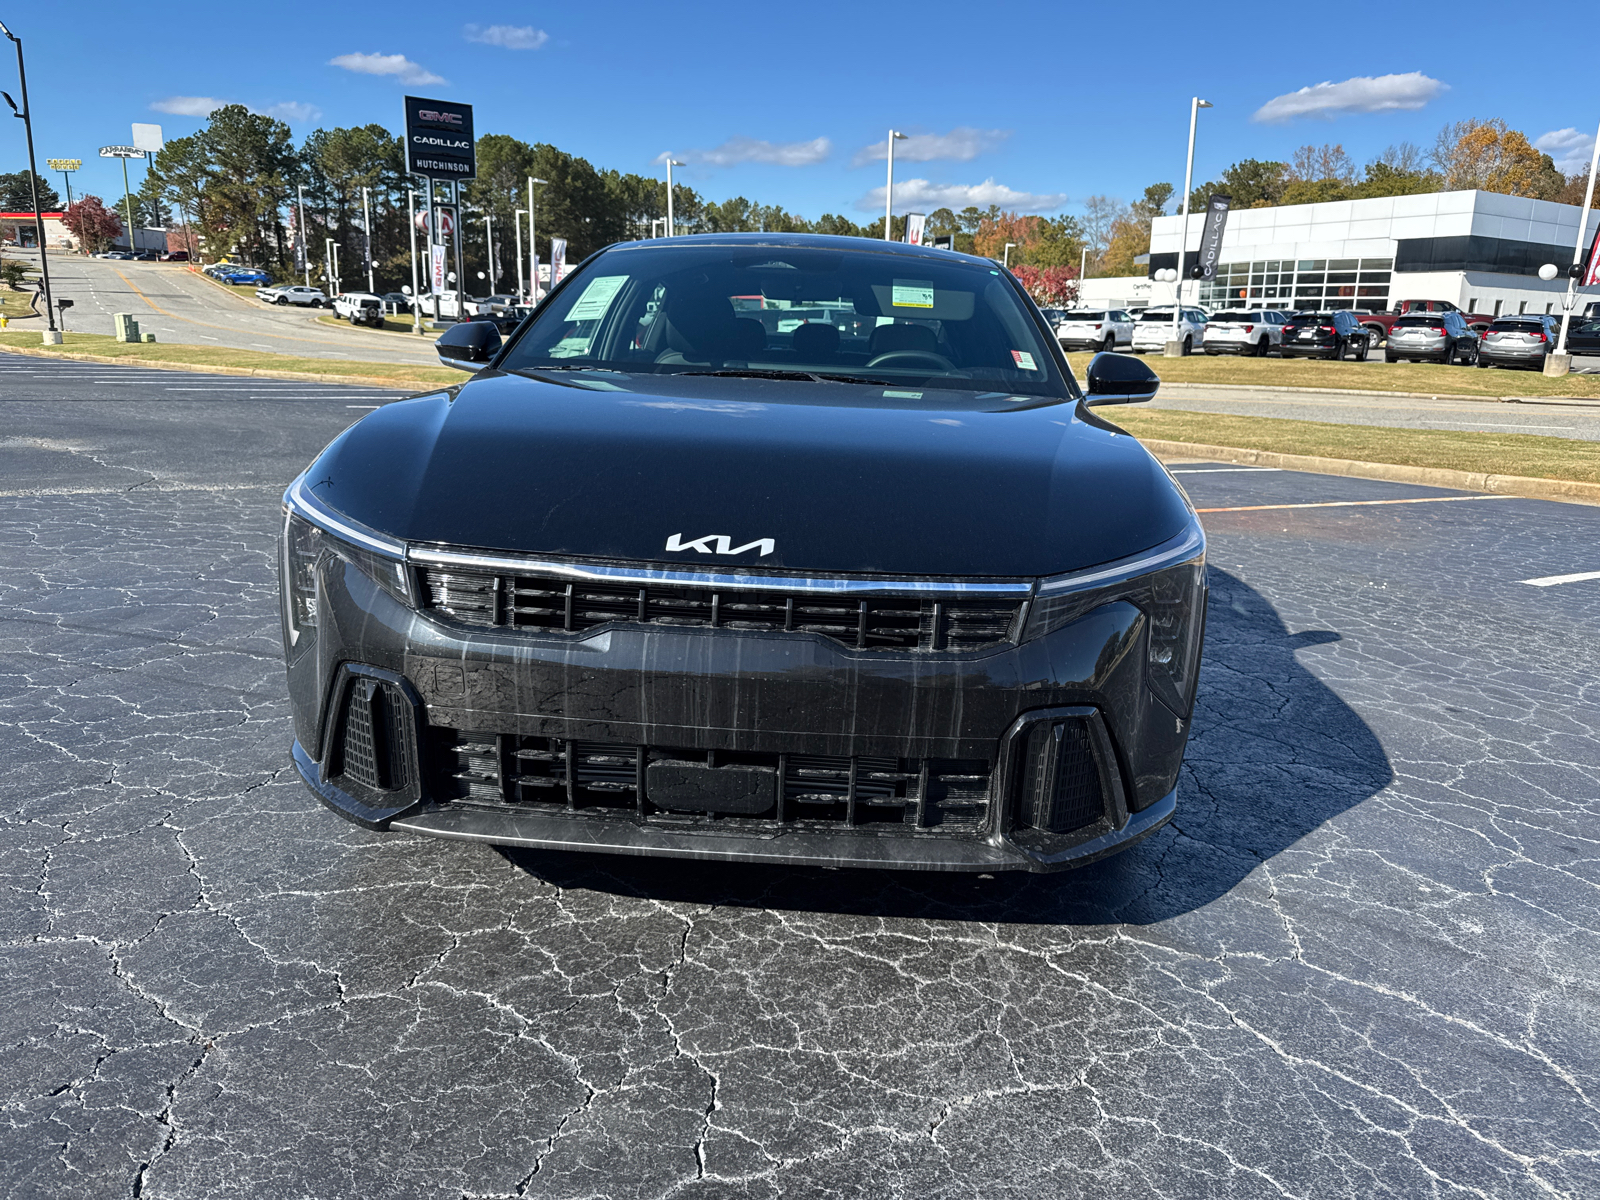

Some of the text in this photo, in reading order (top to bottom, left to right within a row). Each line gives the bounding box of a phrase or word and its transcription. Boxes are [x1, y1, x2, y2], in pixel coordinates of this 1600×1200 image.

[418, 109, 463, 125] GMC
[413, 135, 470, 149] CADILLAC
[416, 159, 470, 173] HUTCHINSON
[1204, 213, 1223, 276] CADILLAC
